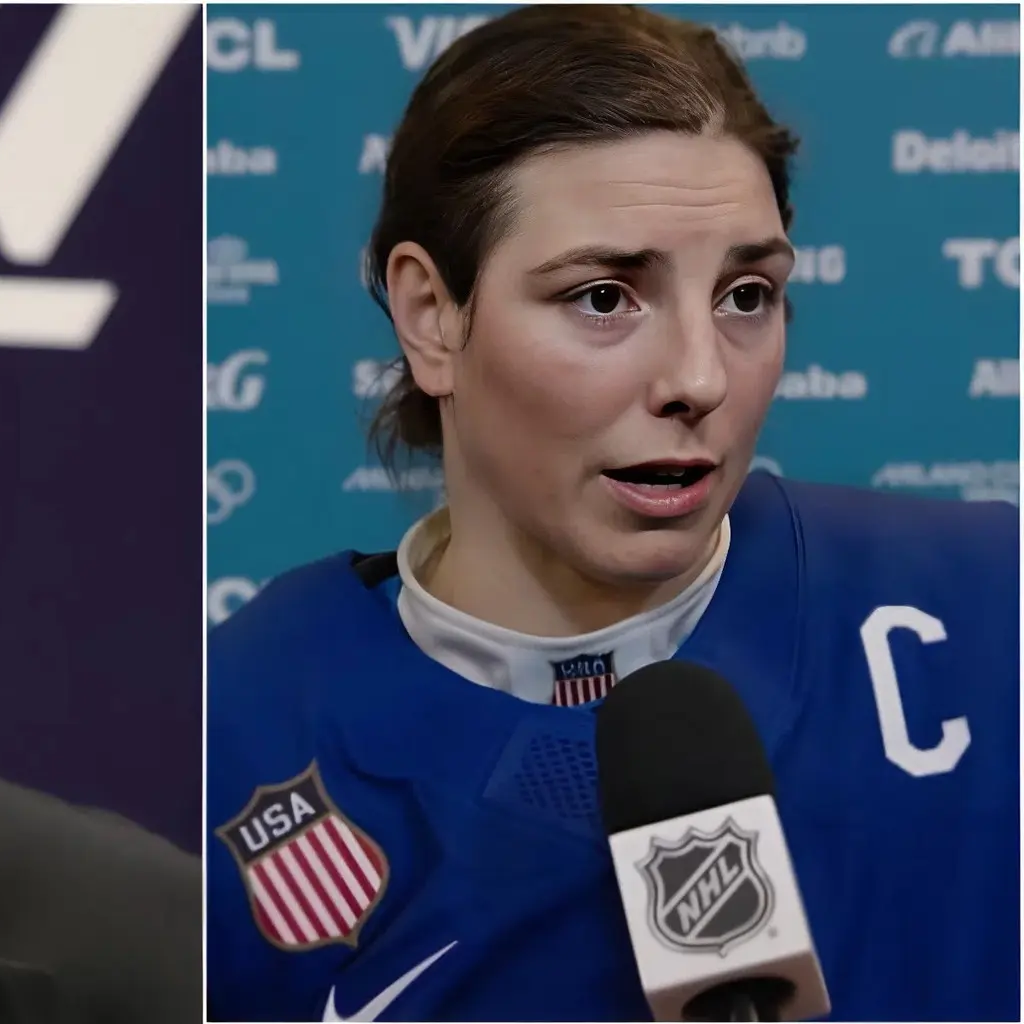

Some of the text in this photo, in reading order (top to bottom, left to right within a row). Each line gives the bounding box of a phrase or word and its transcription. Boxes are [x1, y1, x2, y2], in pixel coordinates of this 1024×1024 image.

[860, 605, 972, 777] C
[239, 792, 317, 852] USA
[677, 856, 741, 934] NHL
